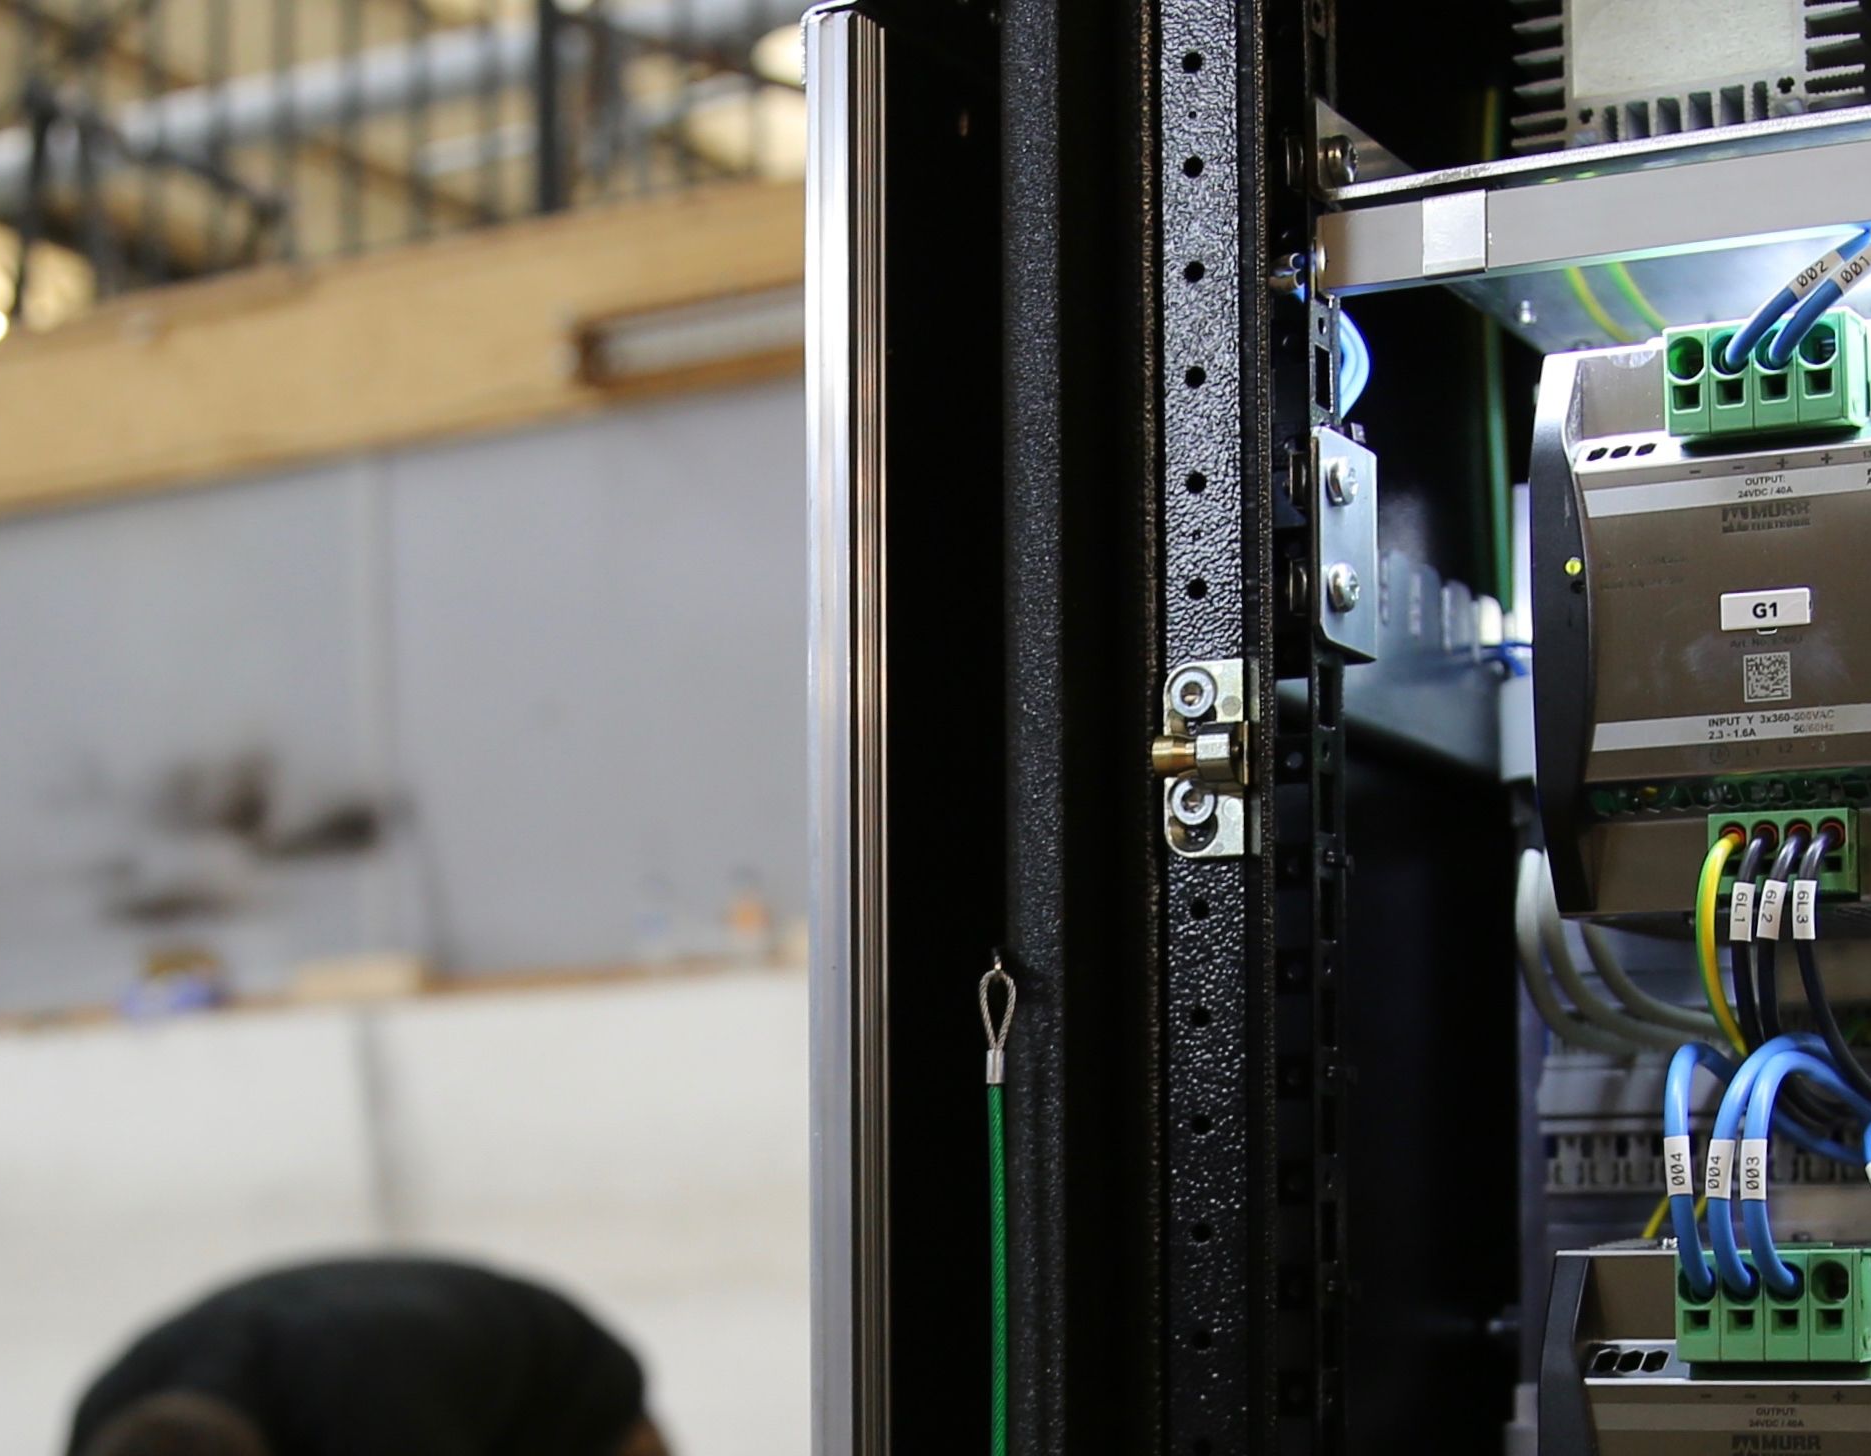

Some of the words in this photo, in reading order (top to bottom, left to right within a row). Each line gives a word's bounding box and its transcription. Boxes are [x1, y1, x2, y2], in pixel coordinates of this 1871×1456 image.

[1796, 260, 1830, 289] 002
[1738, 489, 1769, 500] 24VDC
[1777, 486, 1794, 496] 40A
[1753, 602, 1779, 620] G1
[1709, 717, 1743, 729] INPUT
[1709, 729, 1726, 741] 2.3
[1733, 892, 1748, 923] 6L1
[1761, 889, 1777, 923] 6L2
[1796, 890, 1810, 925] 6L3
[1670, 1152, 1685, 1187] 004
[1708, 1155, 1722, 1189] 004
[1746, 1157, 1761, 1190] 003
[1762, 1435, 1822, 1450] MURR
